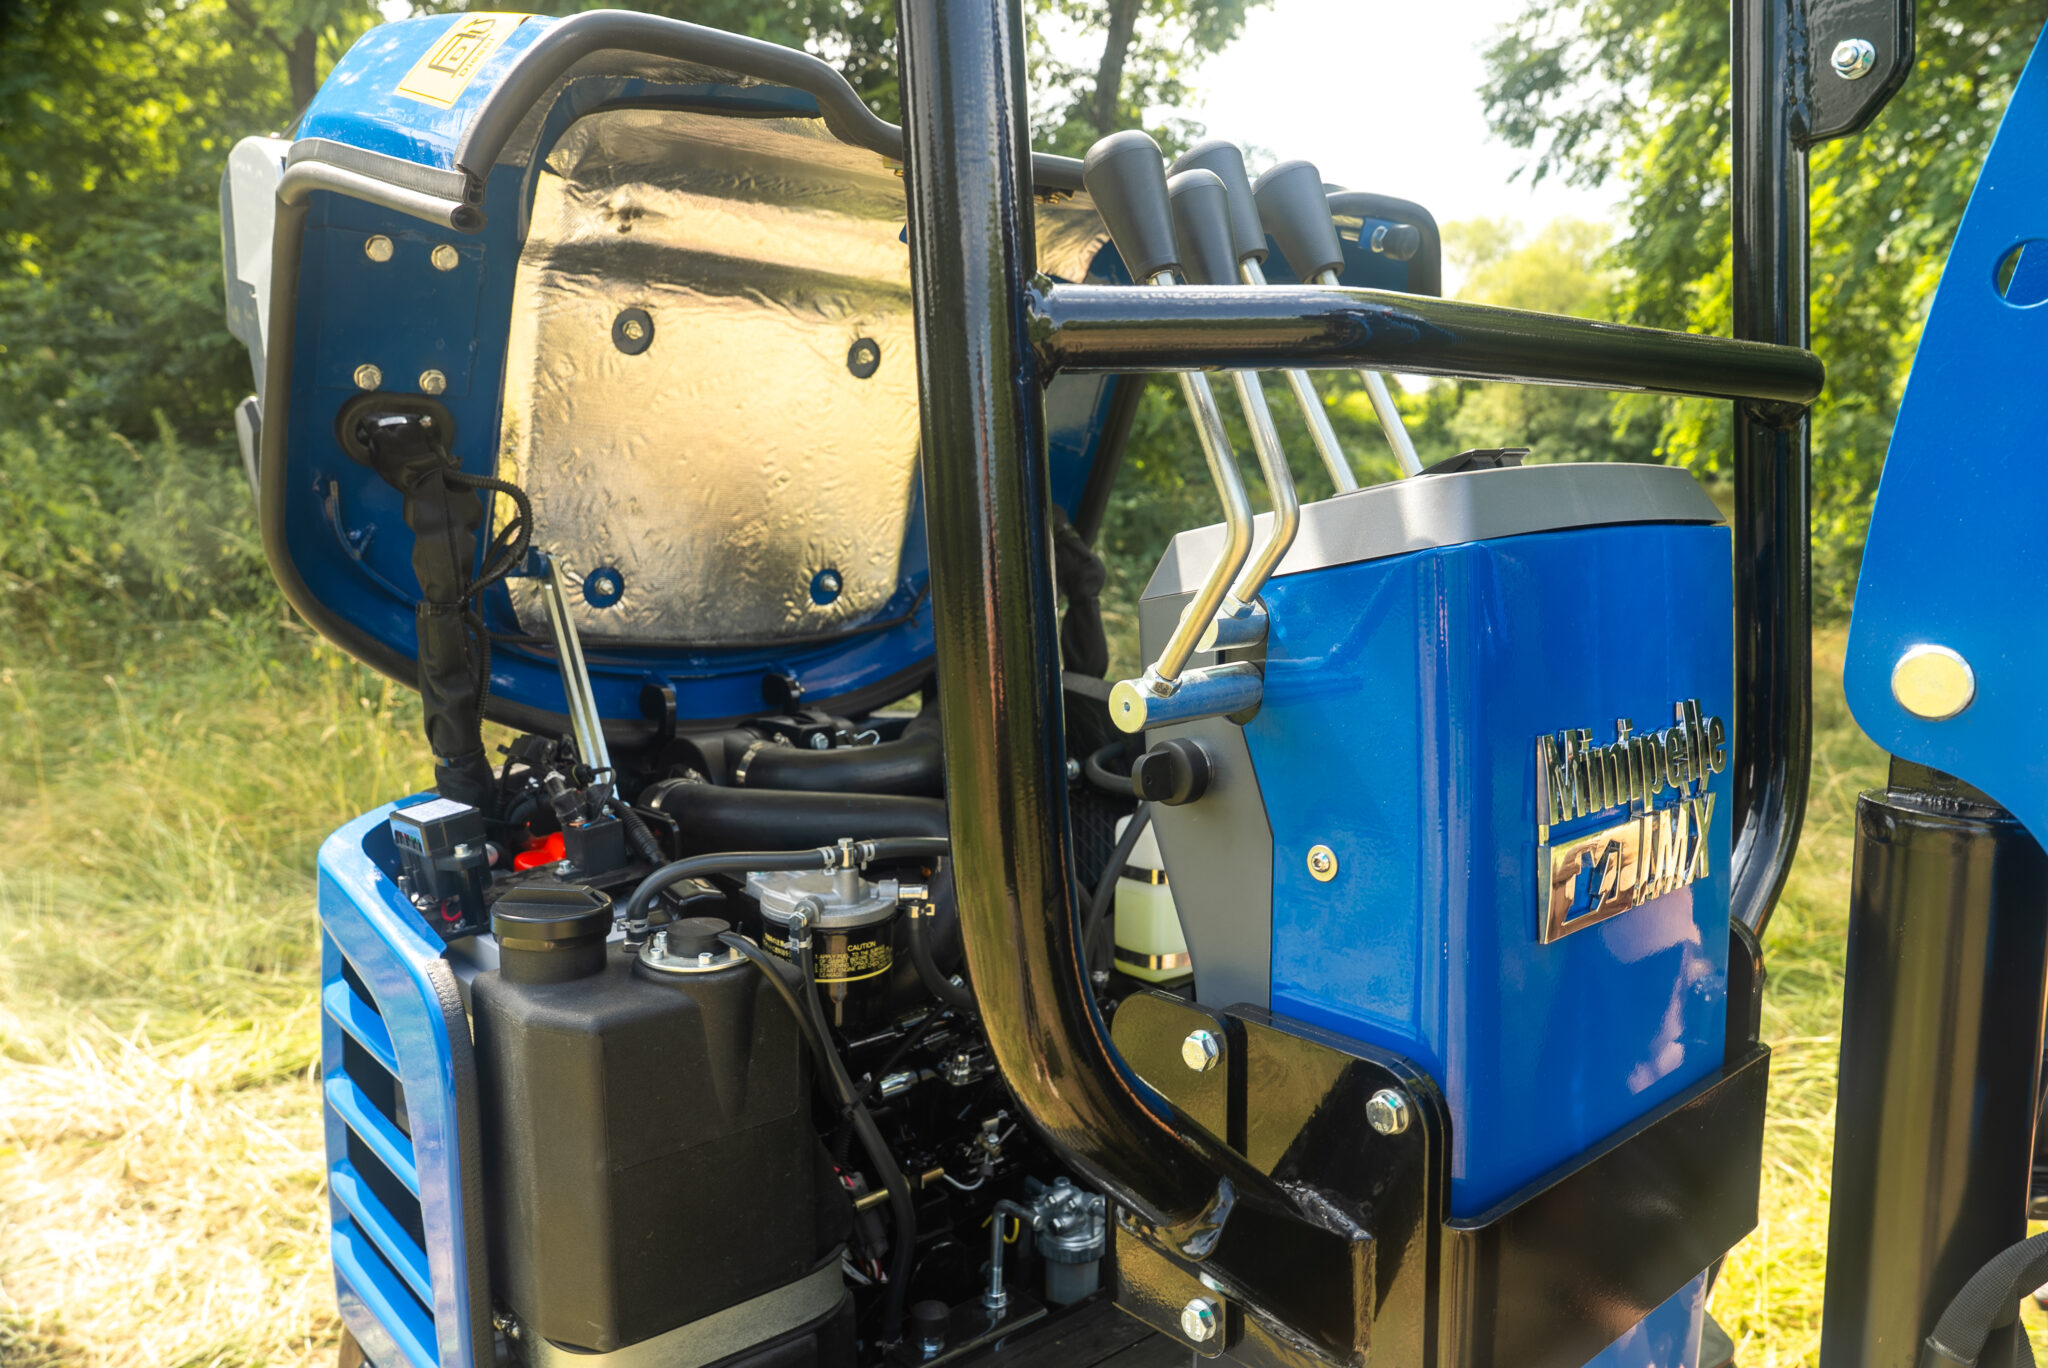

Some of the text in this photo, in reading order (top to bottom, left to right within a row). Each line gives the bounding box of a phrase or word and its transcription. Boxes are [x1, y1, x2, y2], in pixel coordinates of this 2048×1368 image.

[1537, 699, 1727, 826] Minipelle
[1634, 792, 1717, 907] IMX
[847, 940, 876, 952] CAUTION
